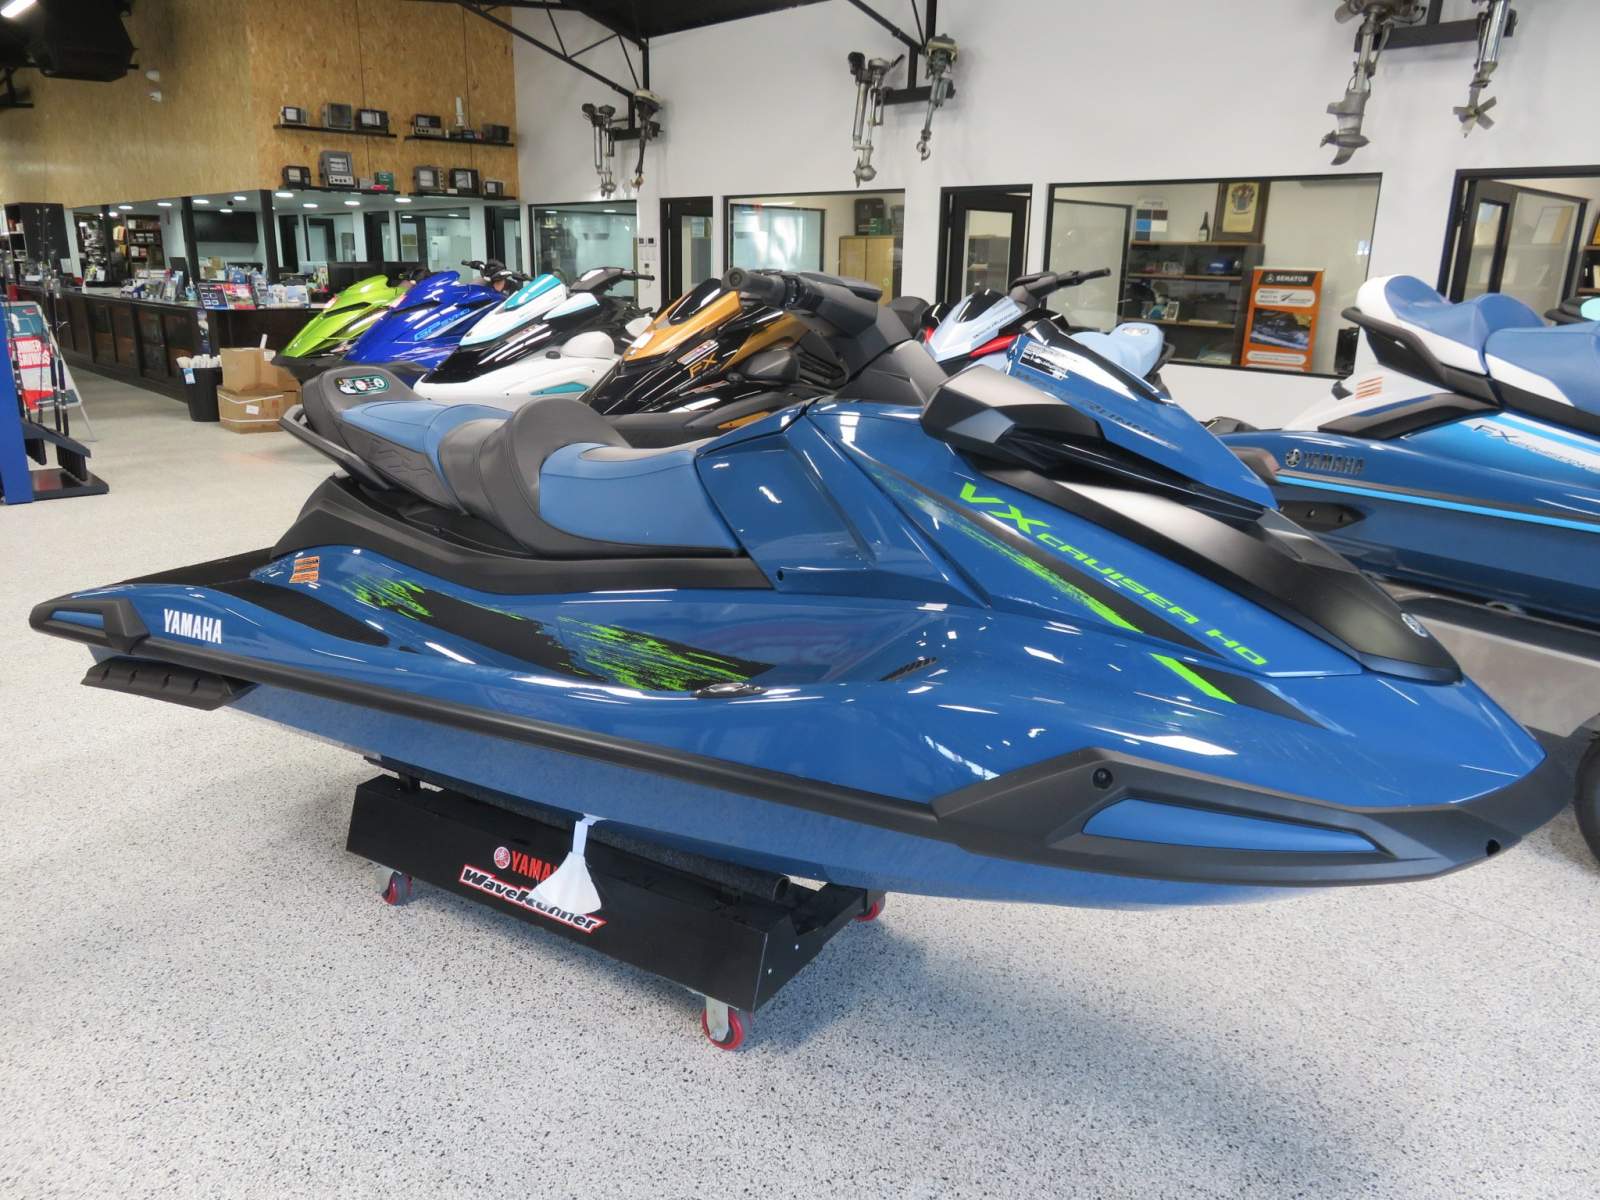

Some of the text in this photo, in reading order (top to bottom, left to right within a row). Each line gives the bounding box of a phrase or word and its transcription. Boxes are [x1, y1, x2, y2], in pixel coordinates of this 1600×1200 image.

[1275, 274, 1309, 283] SENATOR
[688, 351, 718, 379] FX
[1473, 424, 1518, 442] FX
[1302, 450, 1366, 476] YAMAHA
[959, 481, 1269, 666] VX CRUISER HO
[163, 608, 222, 645] YAMAHA
[511, 850, 559, 882] YAMA
